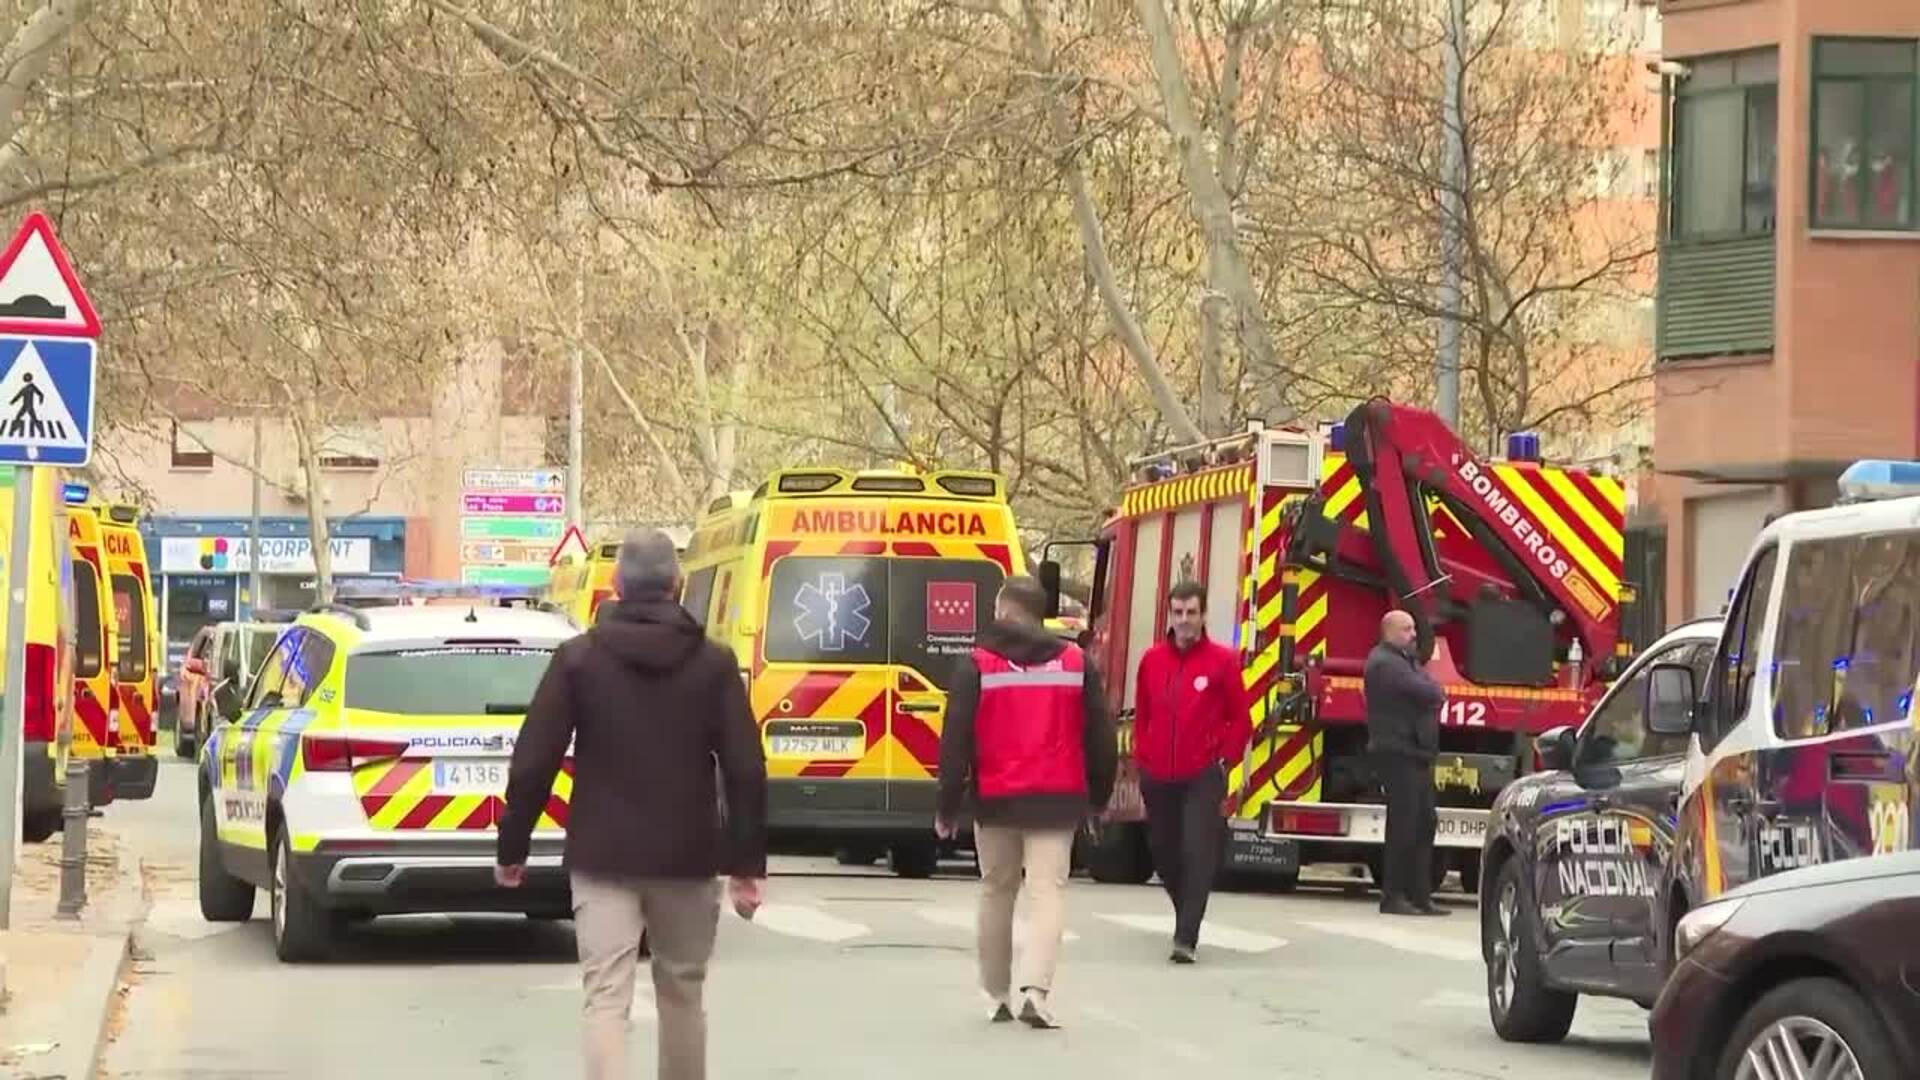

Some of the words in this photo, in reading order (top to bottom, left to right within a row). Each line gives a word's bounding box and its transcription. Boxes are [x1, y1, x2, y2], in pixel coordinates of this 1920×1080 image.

[791, 509, 986, 536] AMBULANCIA
[1458, 460, 1569, 579] BOMBEROS
[235, 539, 353, 558] ACORPNT
[449, 765, 501, 784] 4136
[1556, 818, 1634, 855] POLICIA
[1558, 860, 1656, 897] NACIONAL
